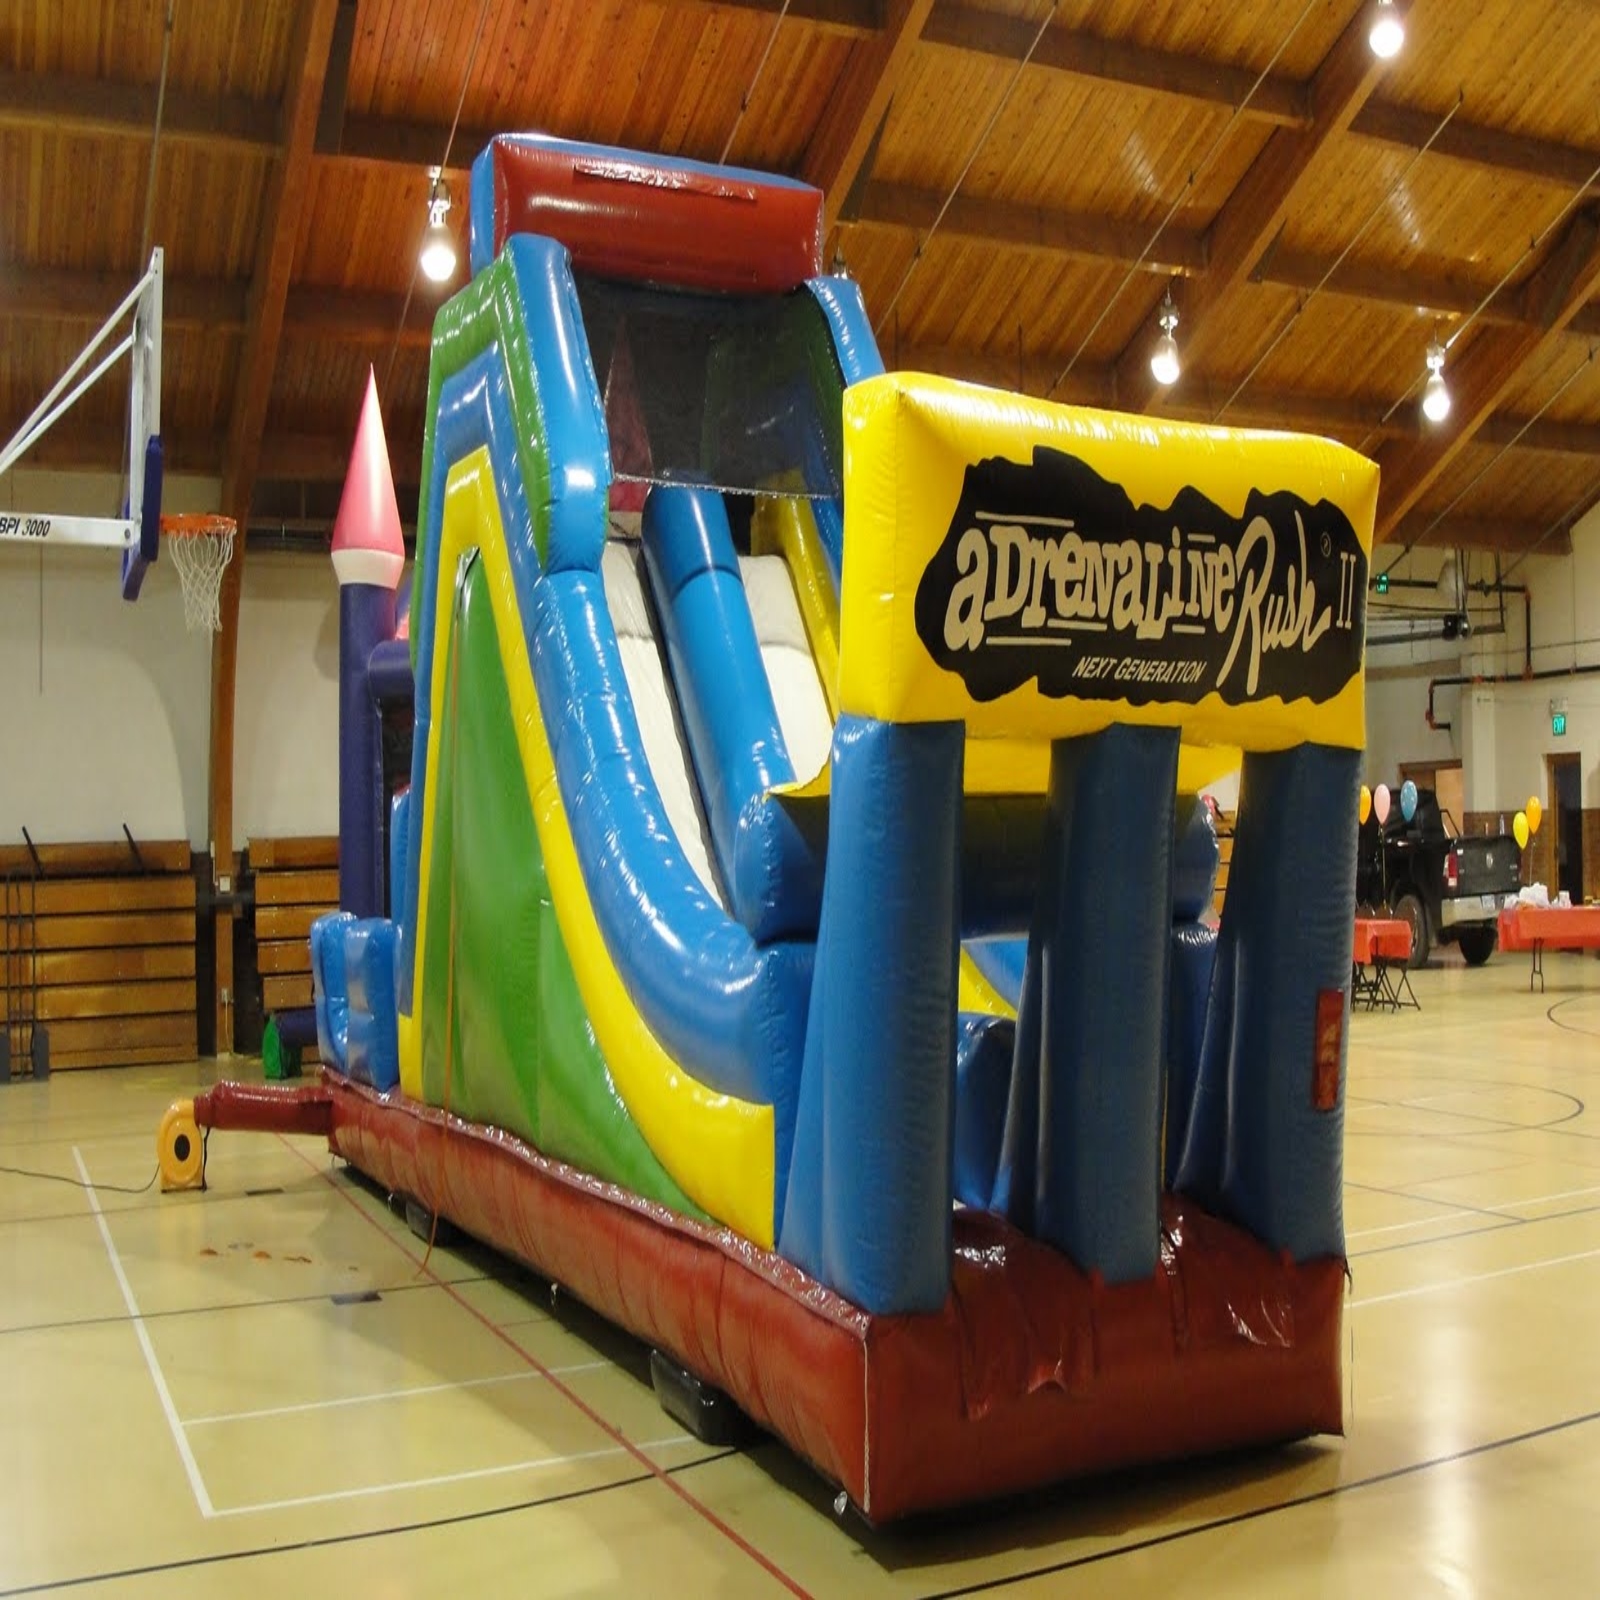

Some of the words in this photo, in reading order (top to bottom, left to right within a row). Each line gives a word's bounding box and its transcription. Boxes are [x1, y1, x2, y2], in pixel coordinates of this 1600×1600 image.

[22, 518, 51, 538] 3000
[1215, 509, 1332, 696] Rush
[1071, 656, 1118, 679] NEXT
[1113, 656, 1208, 684] GENERATION
